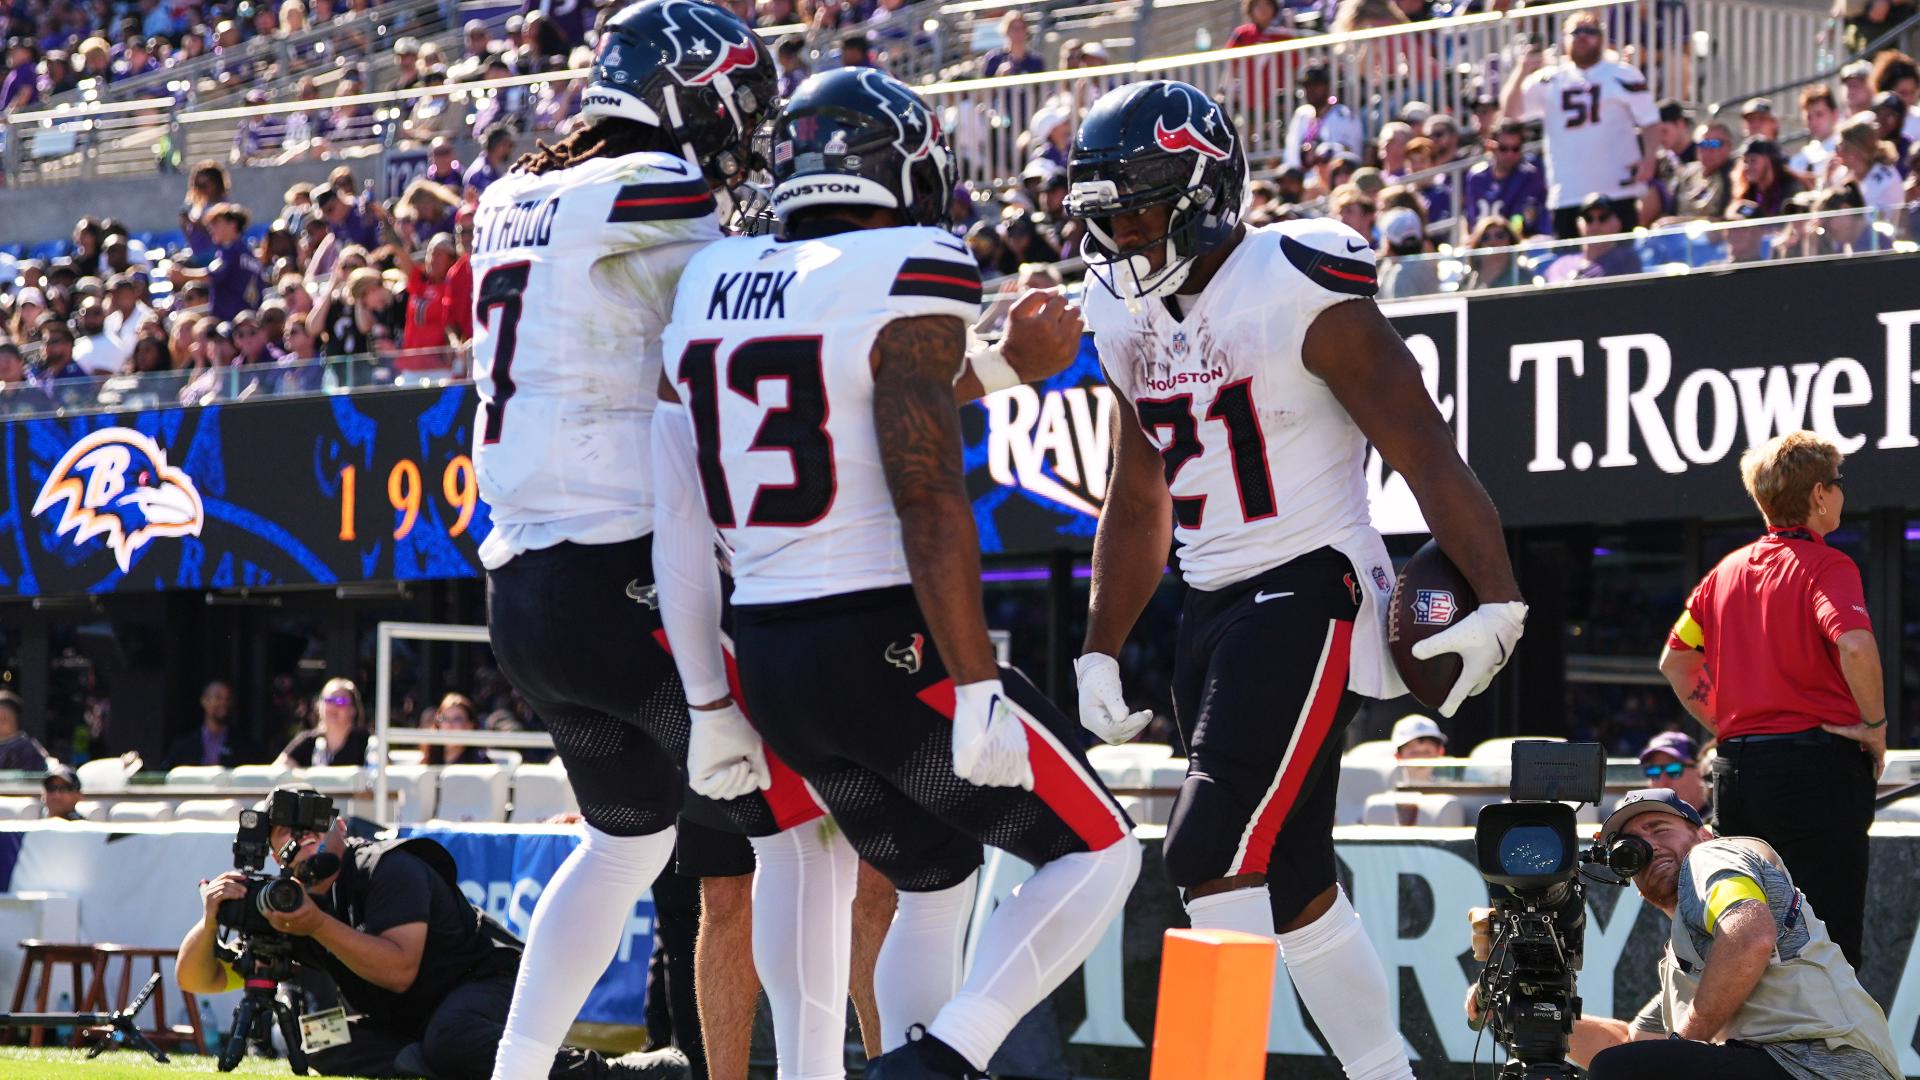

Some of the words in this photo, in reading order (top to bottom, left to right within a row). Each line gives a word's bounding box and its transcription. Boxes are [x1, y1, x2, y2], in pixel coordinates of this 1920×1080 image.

[1561, 84, 1603, 130] 51
[774, 183, 861, 206] HOUSTON
[706, 270, 797, 320] KIRK
[477, 260, 532, 445] 7
[1146, 366, 1224, 391] HOUSTON
[677, 334, 838, 529] 13
[1135, 376, 1278, 529] 21
